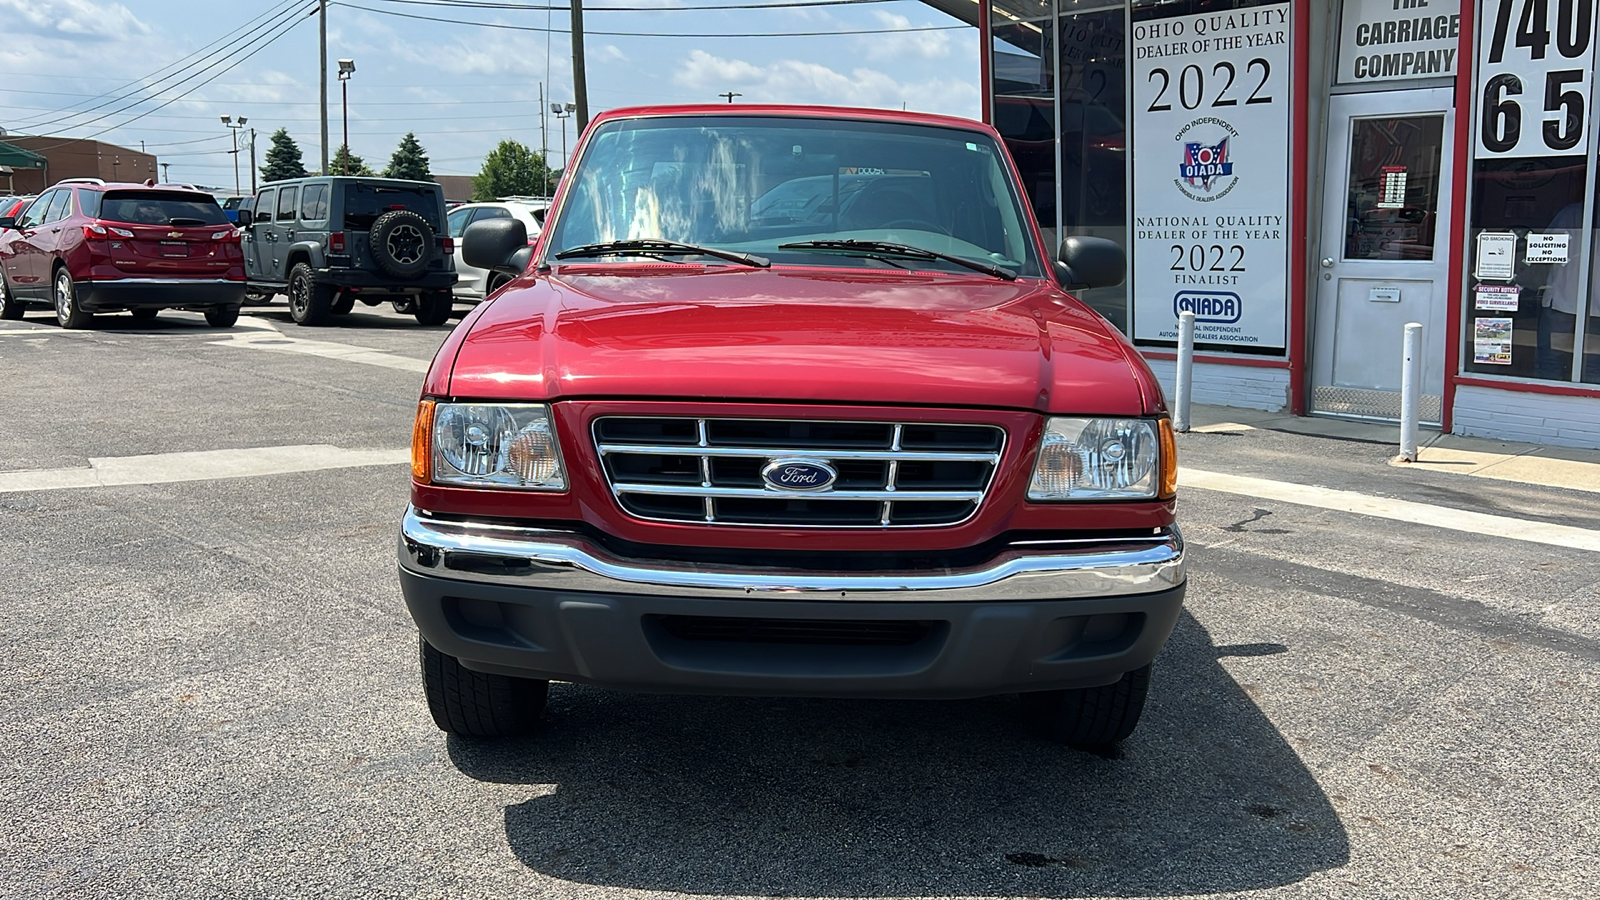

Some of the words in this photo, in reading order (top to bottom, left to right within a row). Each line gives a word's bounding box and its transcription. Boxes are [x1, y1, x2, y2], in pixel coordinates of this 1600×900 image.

[1134, 21, 1185, 41] OHIO
[1194, 8, 1289, 35] QUALITY
[1356, 14, 1460, 47] CARRIAGE
[1488, 0, 1592, 64] 740
[1136, 41, 1189, 59] DEALER
[1192, 40, 1210, 54] OF
[1212, 35, 1243, 51] THE
[1246, 30, 1286, 48] YEAR
[1354, 48, 1457, 79] COMPANY
[1147, 57, 1273, 113] 2022
[1175, 124, 1191, 141] OHIO
[1191, 117, 1239, 138] INDEPENDENT
[1186, 164, 1224, 177] OIADA
[1137, 217, 1209, 227] NATIONAL
[1216, 216, 1283, 228] QUALITY
[1138, 230, 1186, 240] DEALER
[1191, 230, 1208, 240] OF
[1213, 230, 1239, 240] THE
[1245, 230, 1280, 240] YEAR
[1170, 244, 1246, 272] 2022
[1175, 275, 1239, 285] FINALIST
[780, 467, 818, 484] Ford
